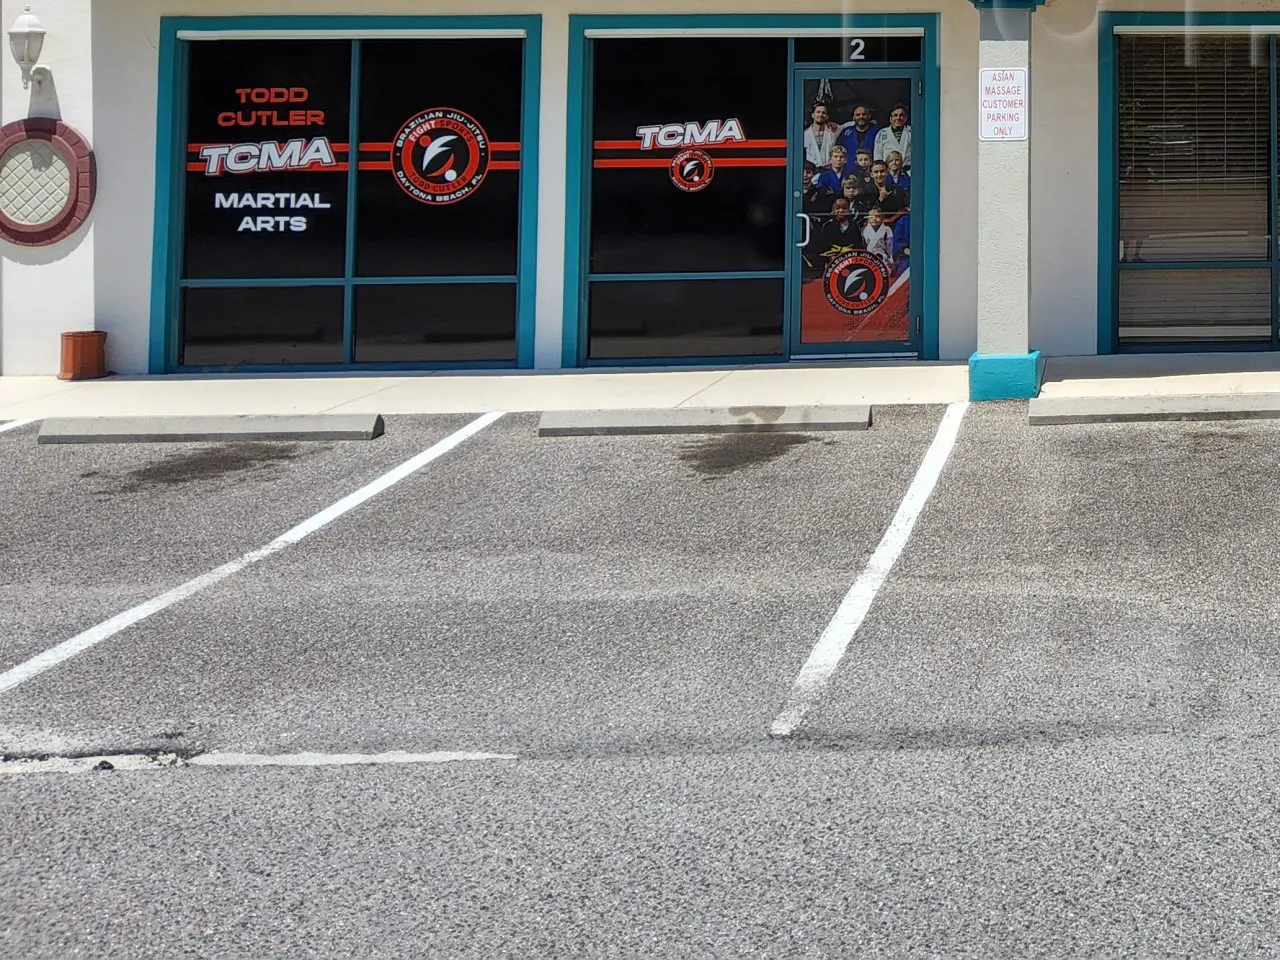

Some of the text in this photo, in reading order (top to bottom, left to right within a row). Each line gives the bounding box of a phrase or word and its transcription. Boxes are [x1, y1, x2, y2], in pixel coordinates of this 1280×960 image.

[850, 38, 865, 60] 2
[992, 72, 1014, 82] ASIAN
[236, 87, 309, 103] TODD
[985, 86, 1021, 95] MASSAGE
[983, 99, 1024, 109] CUSTOMER
[217, 110, 326, 126] CUTLER
[986, 112, 1020, 122] PARKING
[396, 112, 486, 148] BRAZILIAN JIU-JITSU
[408, 120, 474, 142] FIGHT SPORTS
[636, 118, 746, 150] TCMA
[994, 126, 1012, 136] ONLY
[200, 136, 336, 176] TCMA
[397, 170, 482, 201] DAYTONA BEACH, FL
[409, 172, 468, 192] TODD CUTLER
[214, 193, 331, 209] MARTIAL
[237, 216, 308, 232] ARTS
[834, 258, 853, 274] FIGHT
[827, 294, 851, 314] DAYTONA
